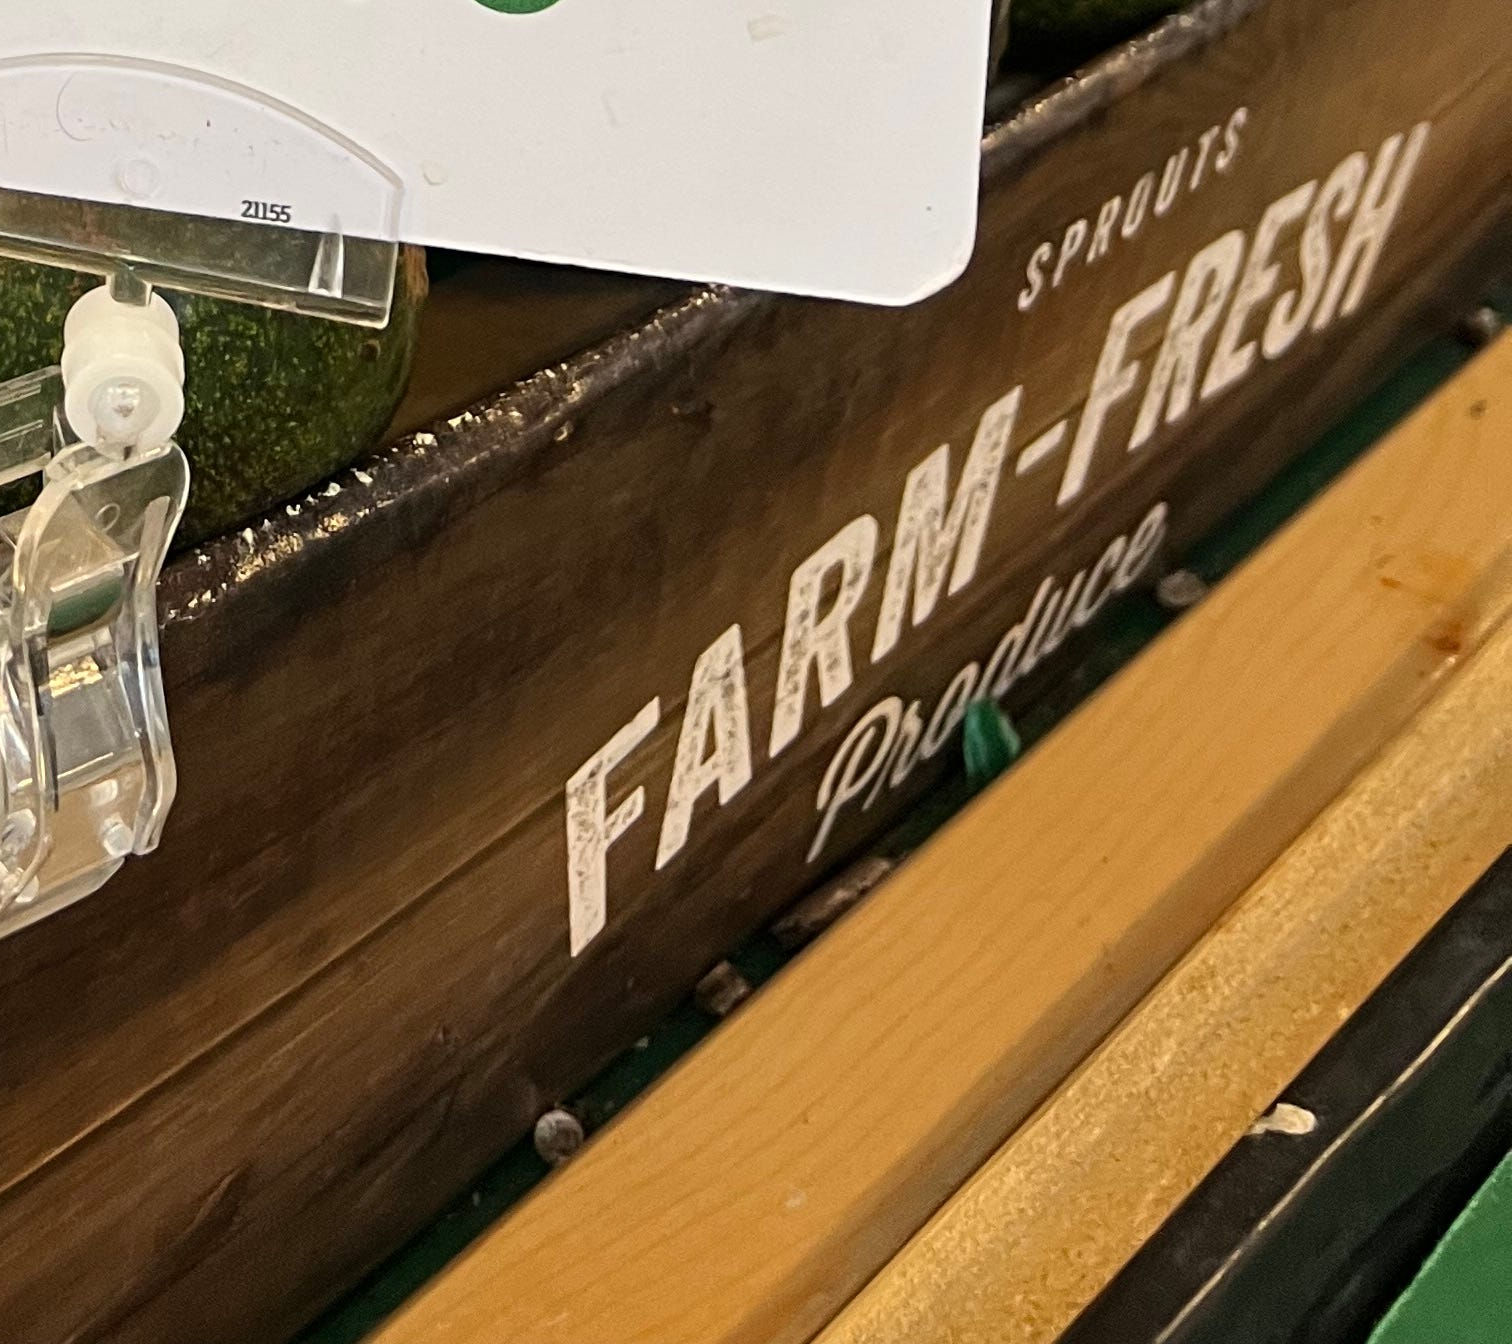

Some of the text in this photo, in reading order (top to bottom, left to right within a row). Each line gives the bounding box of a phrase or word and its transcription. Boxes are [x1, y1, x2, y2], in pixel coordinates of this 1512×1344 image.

[240, 198, 293, 224] 21155
[1018, 107, 1249, 312] SPROUTS
[564, 121, 1433, 958] FARM-FRESH
[806, 500, 1170, 865] Produce
